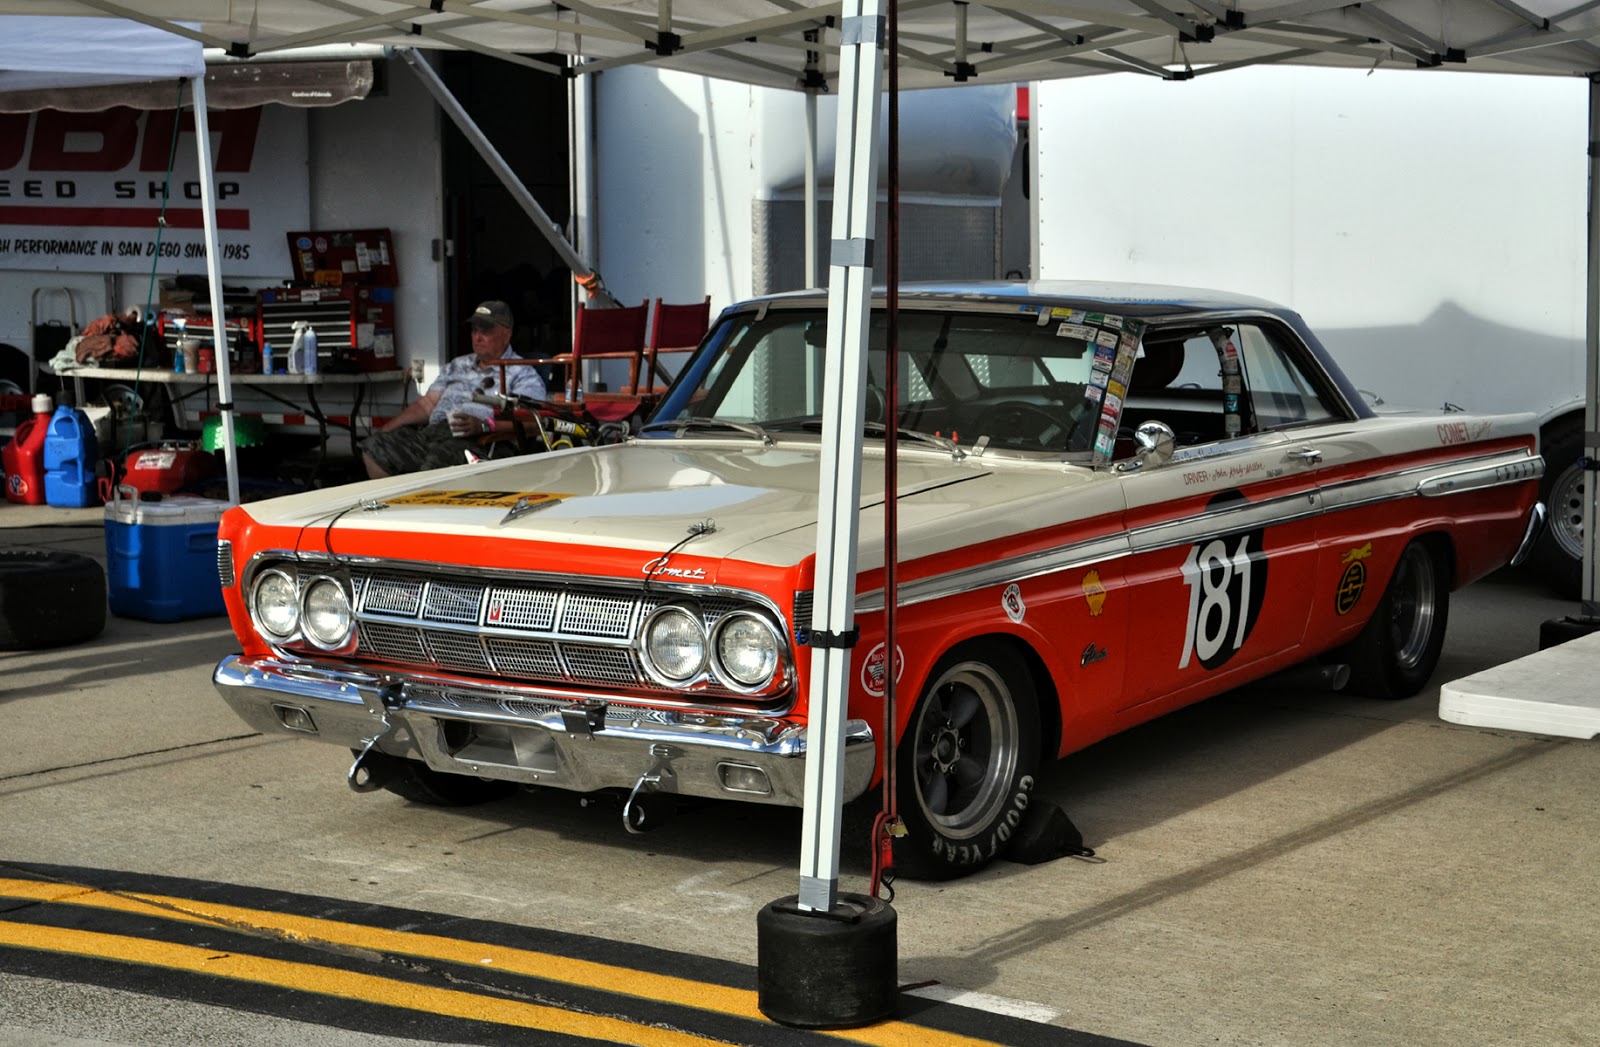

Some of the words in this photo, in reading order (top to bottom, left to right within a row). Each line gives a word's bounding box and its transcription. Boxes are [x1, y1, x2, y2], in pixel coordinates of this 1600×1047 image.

[114, 181, 239, 200] SHOP
[14, 239, 98, 255] PERFORMANCE
[101, 240, 114, 256] IN
[118, 241, 142, 256] SAN
[146, 242, 181, 257] DEGO
[223, 244, 250, 260] 1985
[1437, 421, 1471, 445] COMET
[642, 557, 707, 580] Comet
[1178, 535, 1252, 669] 181
